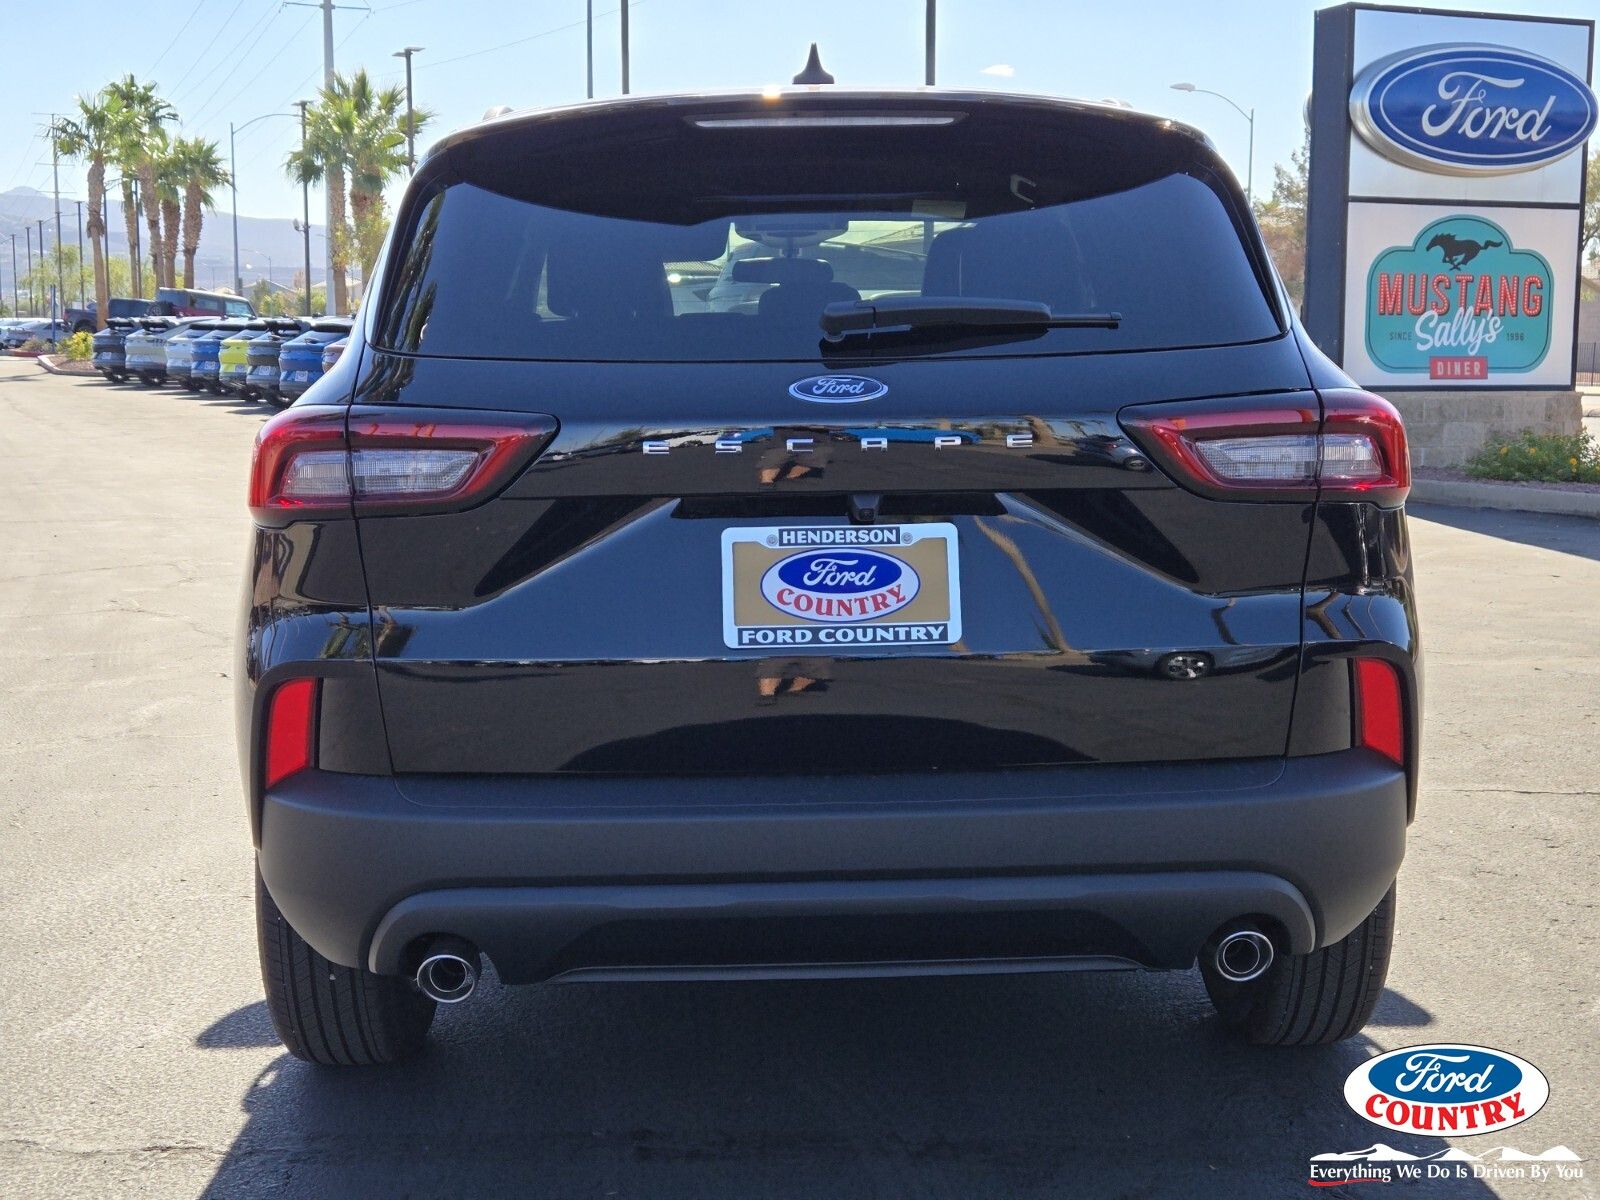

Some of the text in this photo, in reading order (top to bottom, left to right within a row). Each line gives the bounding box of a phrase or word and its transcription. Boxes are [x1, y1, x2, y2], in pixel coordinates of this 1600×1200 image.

[1422, 71, 1556, 142] Ford
[1378, 272, 1543, 316] MUSTANG
[1389, 331, 1412, 341] SINCE
[1414, 308, 1504, 355] Sally's
[1437, 361, 1481, 376] DINER
[812, 378, 864, 396] Ford
[642, 433, 1034, 455] ESCAPE
[782, 530, 897, 544] HENDERSON
[803, 558, 877, 586] Ford
[776, 584, 906, 617] COUNTRY
[741, 626, 945, 645] FORD COUNTRY
